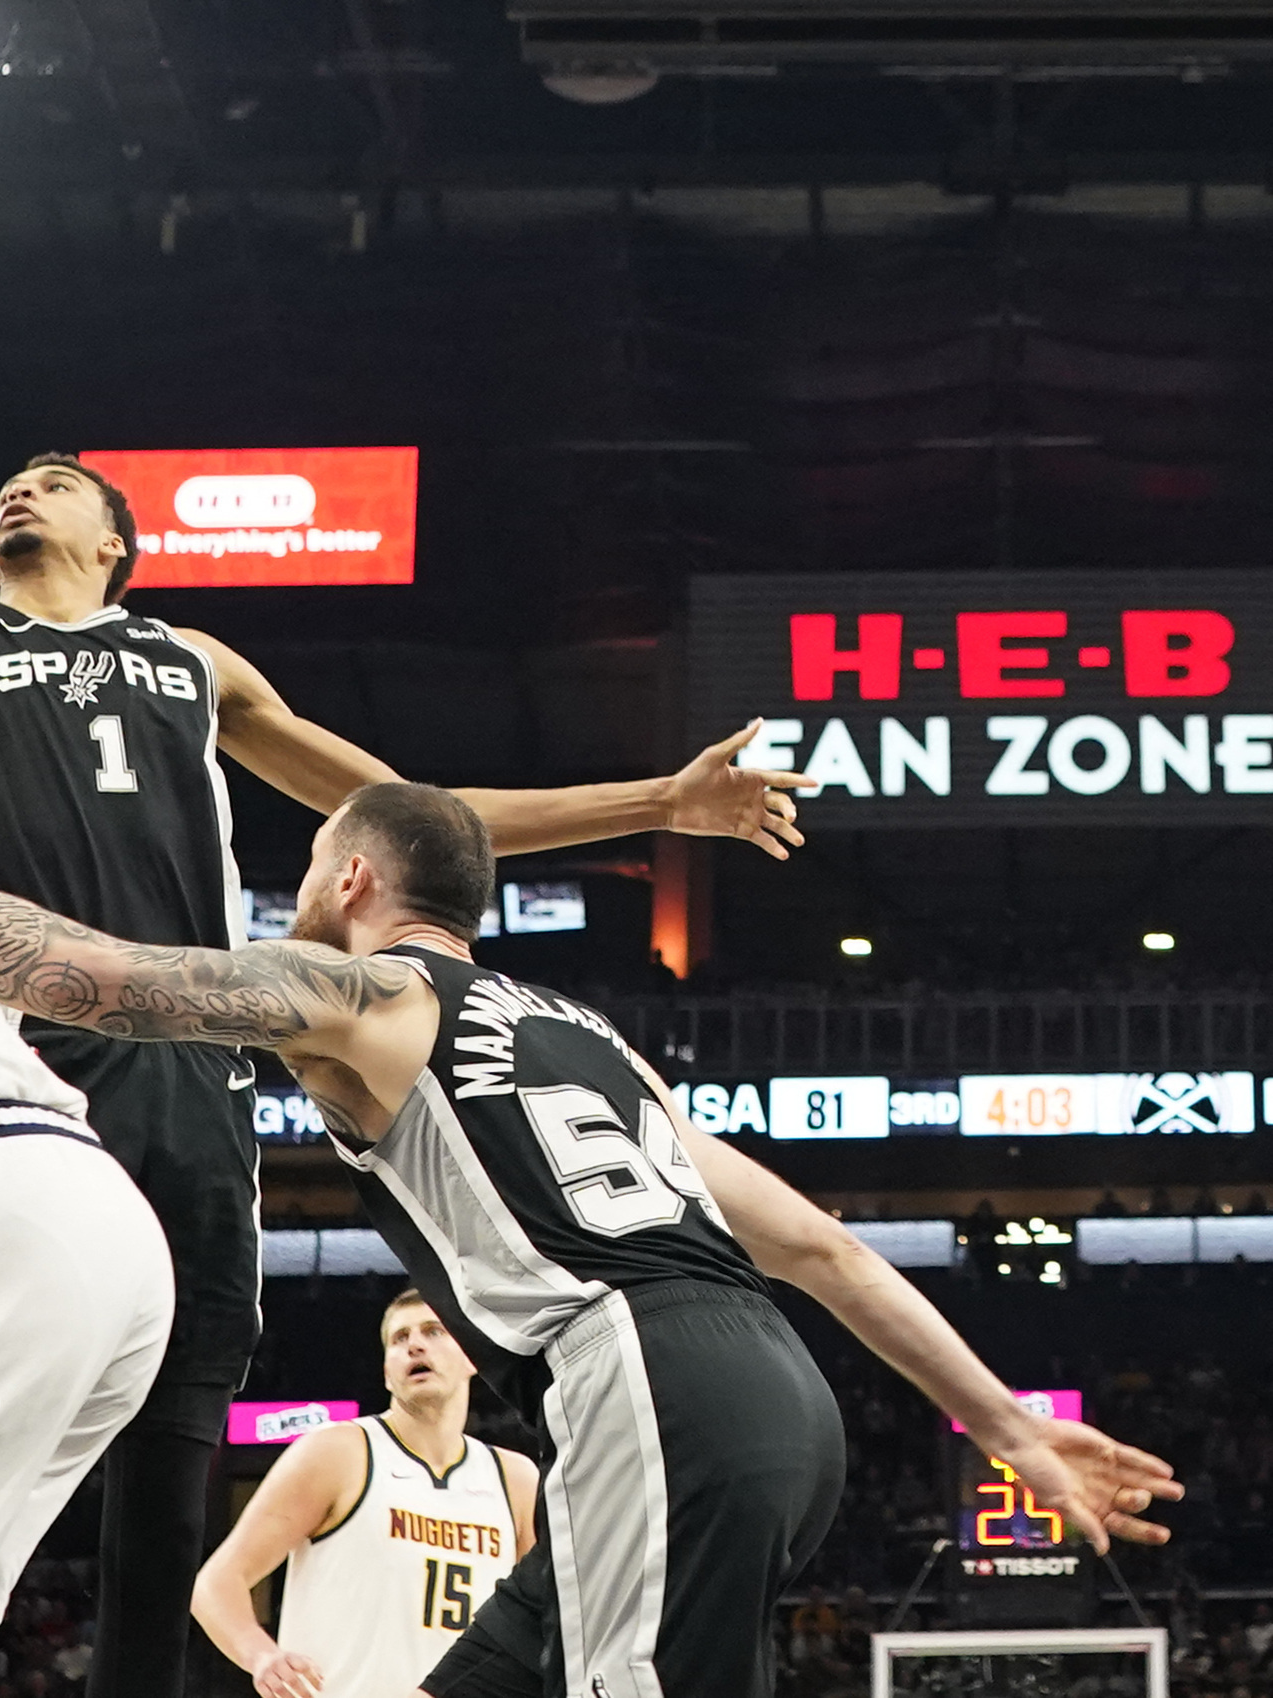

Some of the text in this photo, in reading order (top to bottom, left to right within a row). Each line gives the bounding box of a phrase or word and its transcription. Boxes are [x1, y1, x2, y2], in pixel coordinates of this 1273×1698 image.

[89, 715, 139, 793] 1
[735, 714, 1273, 798] FAN ZONE
[807, 1090, 843, 1130] 81
[889, 1091, 961, 1126] 3RD
[986, 1087, 1073, 1129] 4:03
[389, 1507, 502, 1558] NUGGETS
[423, 1558, 472, 1631] 15
[992, 1557, 1080, 1576] TISSOT
